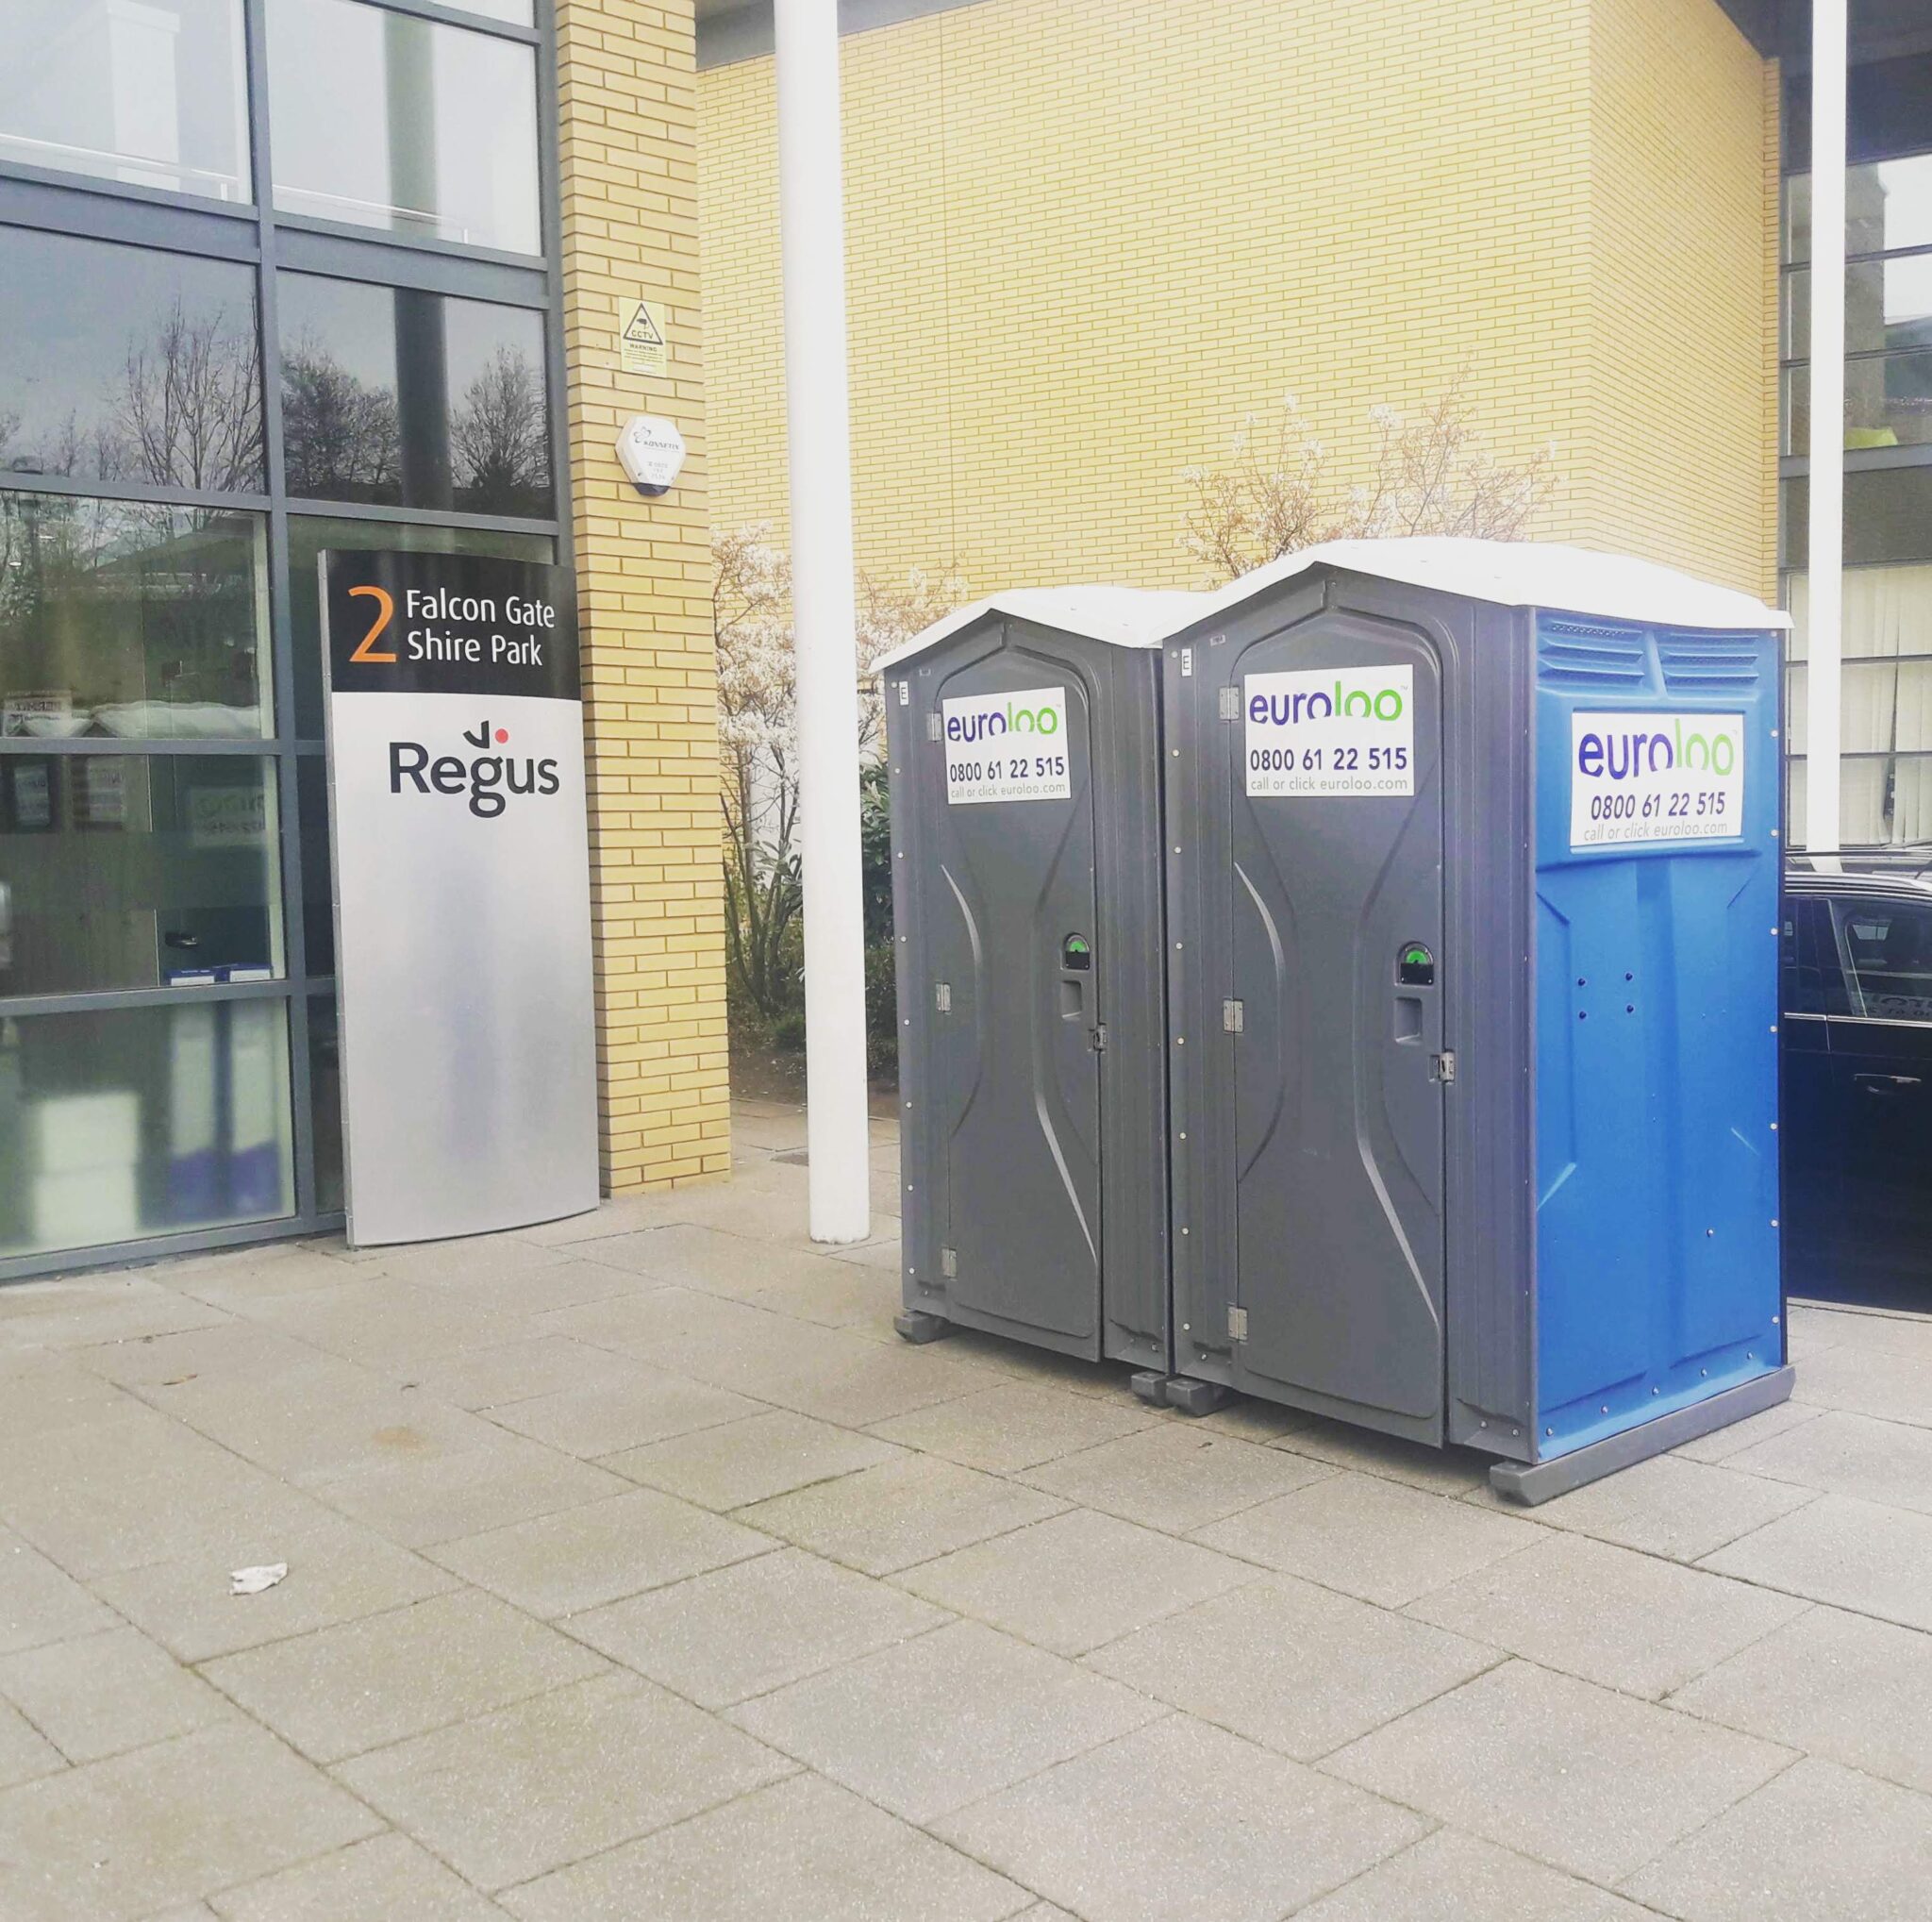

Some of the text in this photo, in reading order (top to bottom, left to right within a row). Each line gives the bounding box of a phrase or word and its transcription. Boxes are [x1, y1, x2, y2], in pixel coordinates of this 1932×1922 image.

[629, 343, 658, 353] WARNING
[631, 330, 654, 341] CCTV
[407, 587, 555, 628] Falcon Gate
[348, 585, 397, 663] 2
[407, 627, 543, 667] Shire Park
[1249, 680, 1403, 726] euroloo
[947, 701, 1058, 743] euroloo
[1250, 746, 1407, 771] 0800 61 22 515
[1578, 718, 1734, 780] euroloo
[389, 742, 560, 819] Regus
[950, 756, 1065, 782] 0800 61 22 515
[951, 782, 1066, 798] call or click euroloo.com
[1251, 777, 1407, 791] call or click euroloo.com
[1591, 792, 1725, 821] 0800 61 22 515
[1584, 820, 1728, 842] call or click euroloo.com
